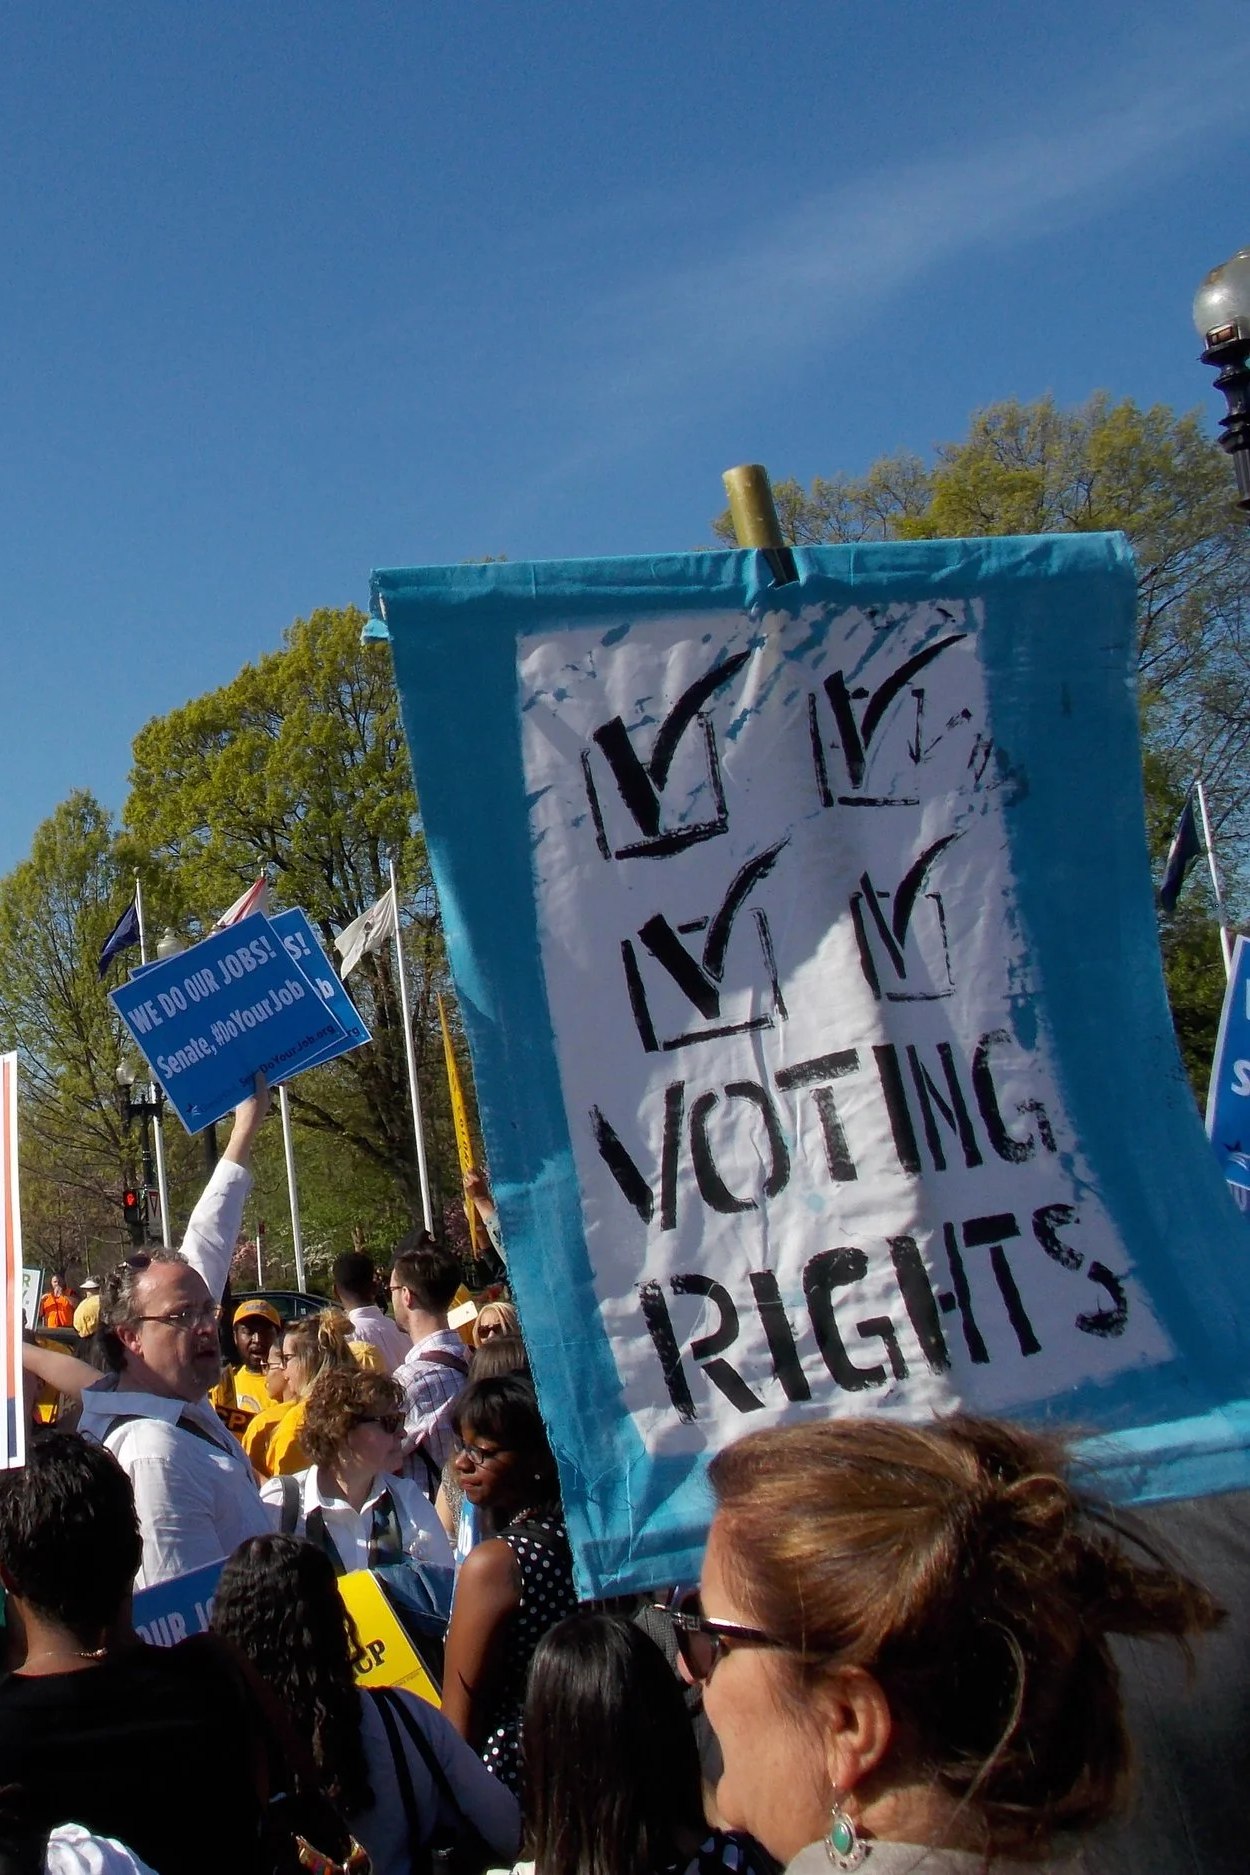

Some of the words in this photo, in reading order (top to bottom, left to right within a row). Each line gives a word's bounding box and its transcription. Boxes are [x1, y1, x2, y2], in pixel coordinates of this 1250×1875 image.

[127, 1003, 163, 1035] WE
[157, 986, 188, 1018] DO
[183, 968, 219, 1003] OUR
[217, 935, 277, 985] JOBS!
[156, 1037, 218, 1080] Senate,
[210, 978, 306, 1048] #DoYourJob
[239, 1024, 335, 1087] SeDoYourJob.org
[587, 1028, 1057, 1232] VOTING
[634, 1202, 1130, 1425] RIGHTS
